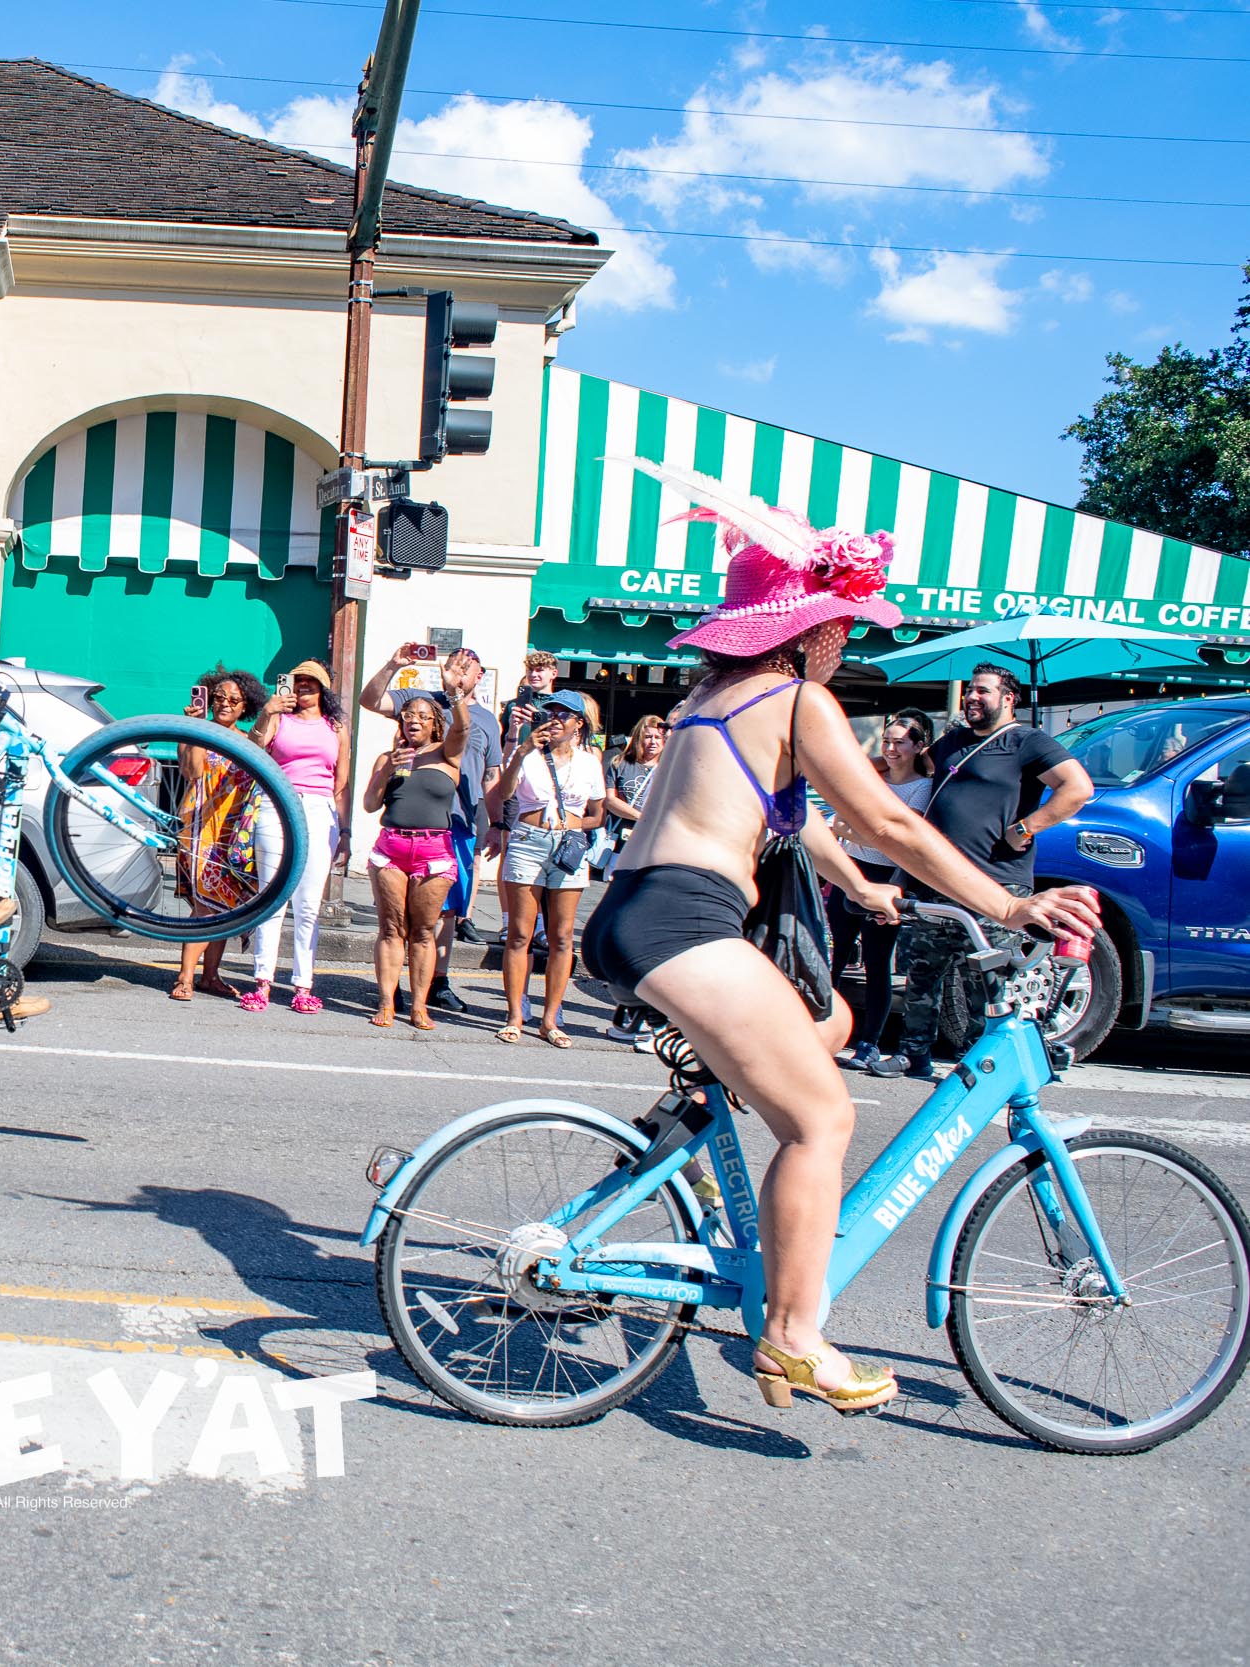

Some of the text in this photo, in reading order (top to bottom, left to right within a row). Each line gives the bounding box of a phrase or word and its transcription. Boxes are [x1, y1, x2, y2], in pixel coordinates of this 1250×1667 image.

[375, 481, 407, 497] St. Ann
[354, 536, 369, 547] ANY
[353, 548, 369, 562] TIME
[620, 570, 701, 596] CAFE
[916, 587, 983, 613] THE
[1185, 926, 1250, 939] TITA
[872, 1114, 973, 1231] BLUE Bikes
[715, 1132, 759, 1239] ELECTRIC
[648, 1286, 660, 1297] by
